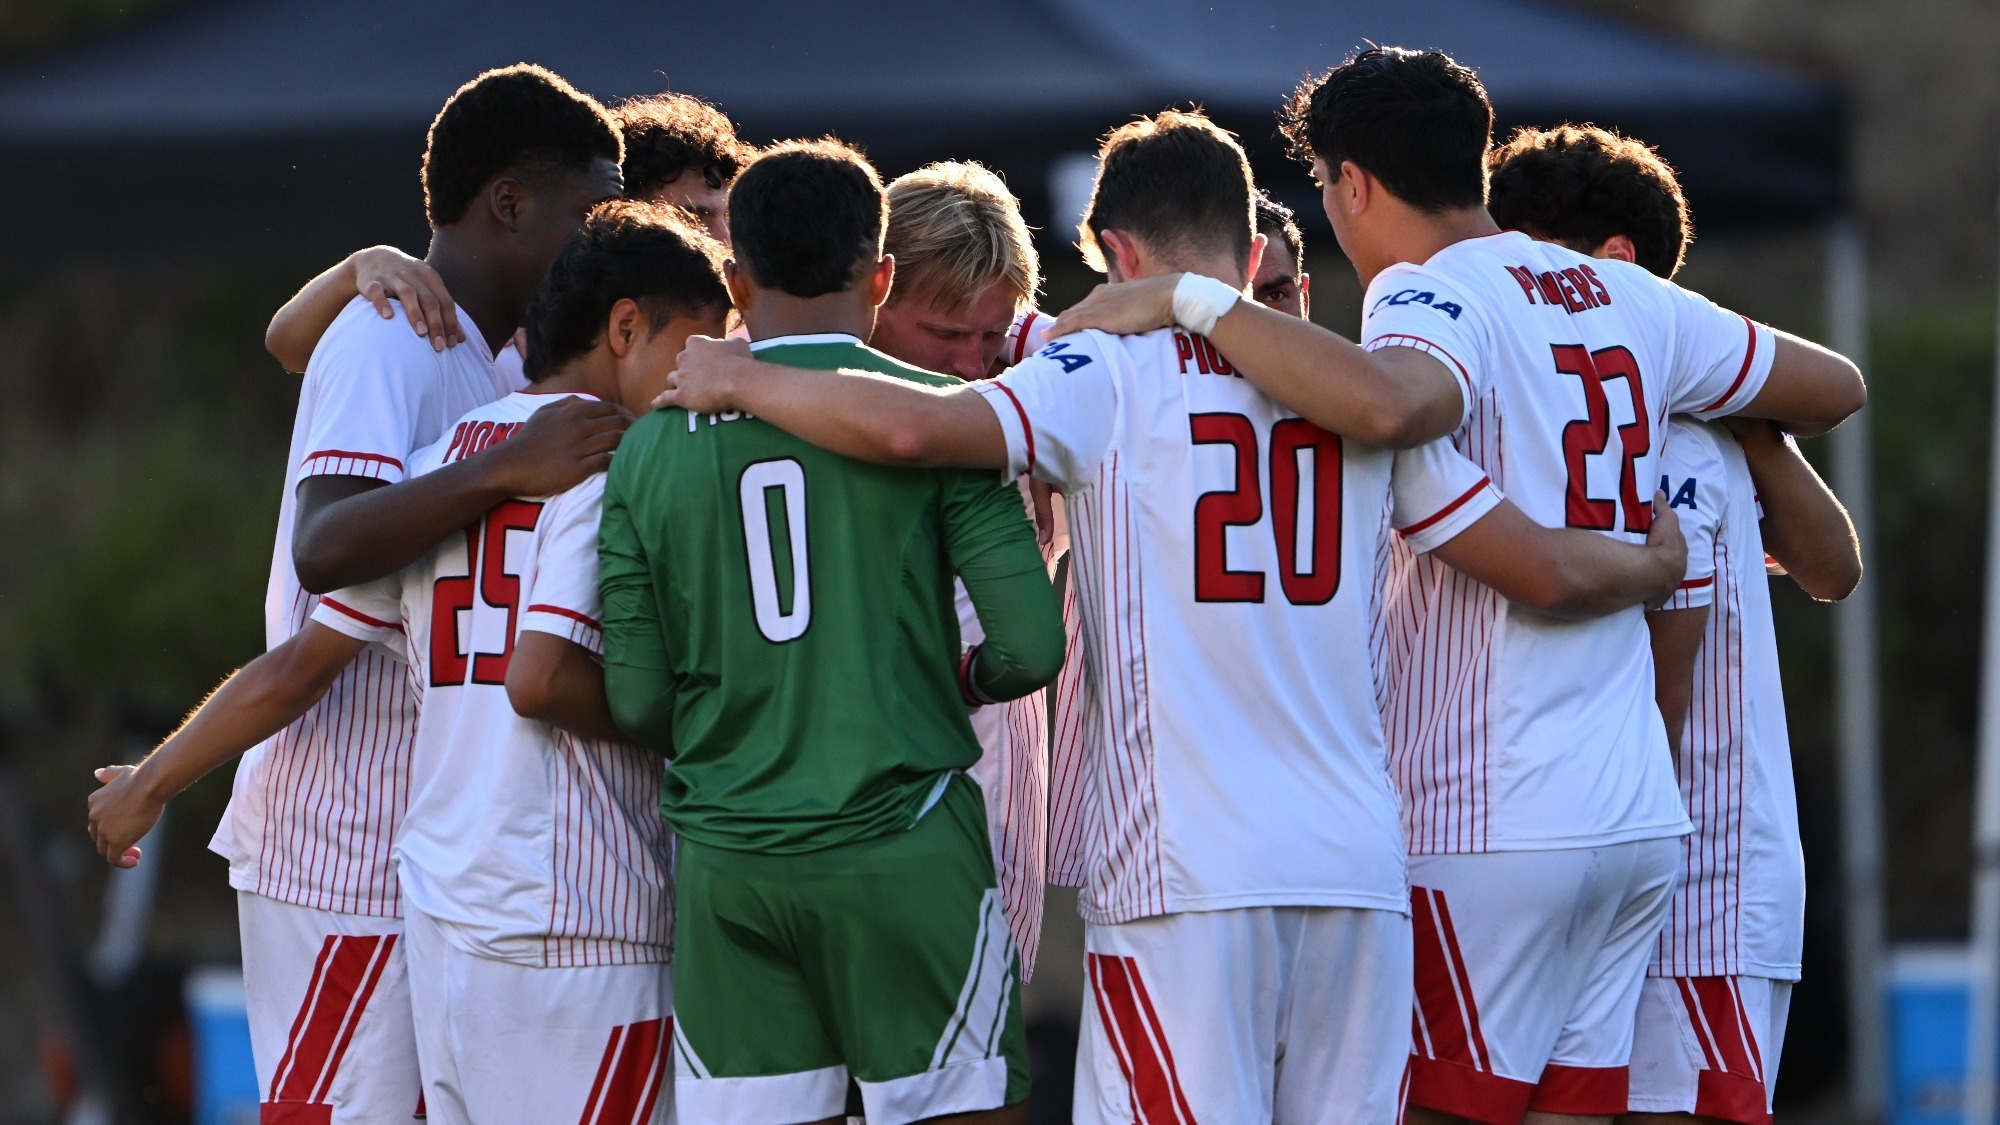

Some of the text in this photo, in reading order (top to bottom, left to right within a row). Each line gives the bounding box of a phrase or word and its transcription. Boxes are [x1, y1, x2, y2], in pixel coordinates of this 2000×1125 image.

[1174, 332, 1244, 378] PIO
[1549, 343, 1653, 534] 22
[430, 498, 545, 687] 25
[737, 455, 814, 645] 0
[1189, 412, 1343, 606] 20
